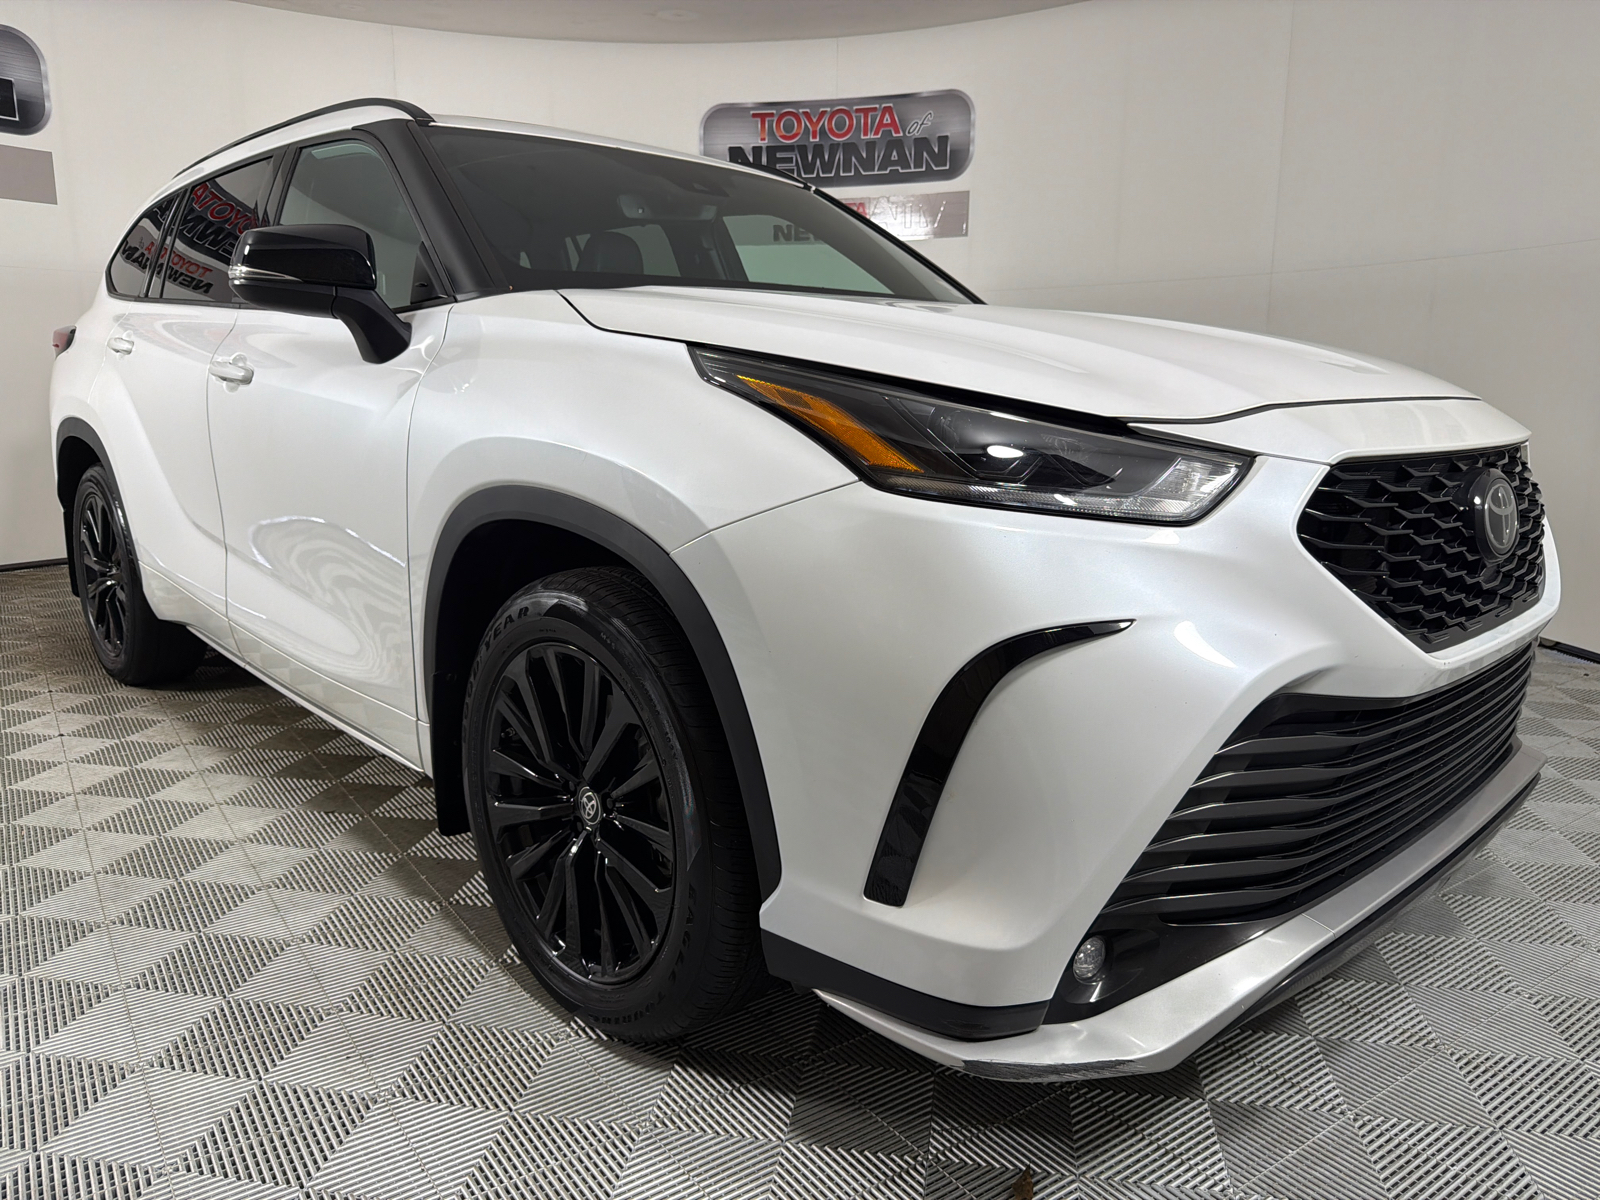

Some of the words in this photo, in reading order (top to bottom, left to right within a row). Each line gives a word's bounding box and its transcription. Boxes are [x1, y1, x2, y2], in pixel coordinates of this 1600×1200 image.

[751, 104, 902, 143] TOYOTA
[906, 111, 933, 136] of
[727, 135, 950, 178] NEWNAN
